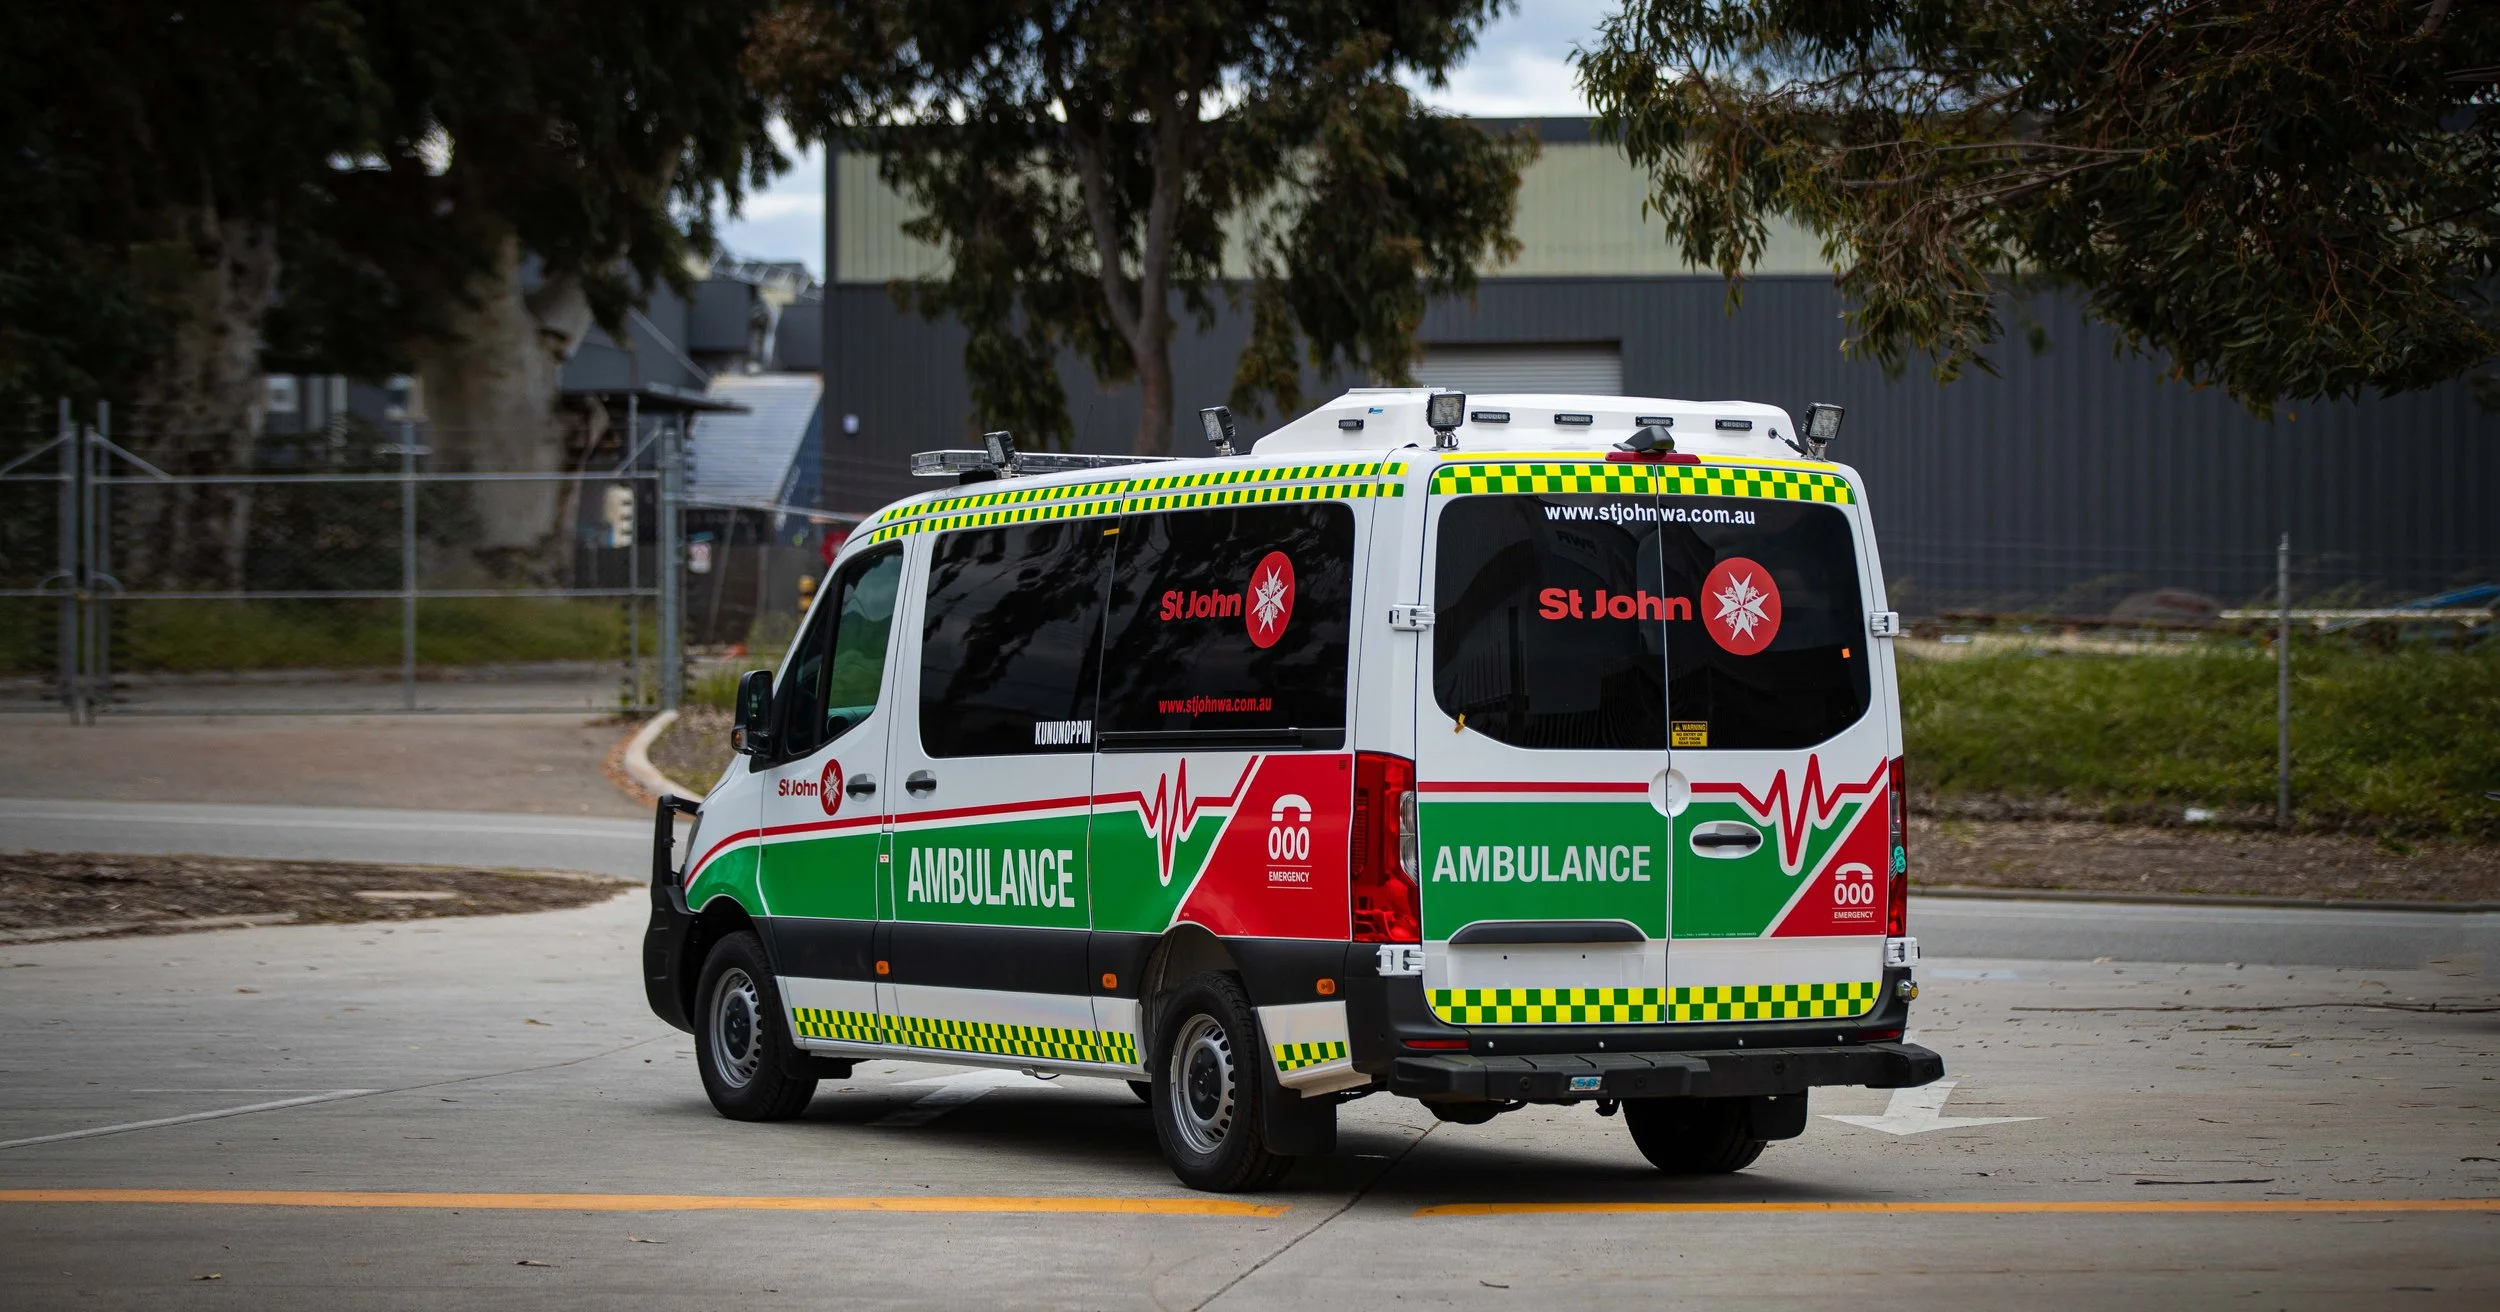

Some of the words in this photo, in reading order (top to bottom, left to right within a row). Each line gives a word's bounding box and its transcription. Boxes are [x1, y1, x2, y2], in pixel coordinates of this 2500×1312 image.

[1544, 503, 1756, 525] www.stjohnwa.com.au
[1159, 590, 1184, 621] St
[1185, 589, 1242, 619] John
[1538, 587, 1583, 620] St
[1591, 589, 1693, 621] John
[1159, 695, 1273, 718] www.stjohnwa.com.au
[1034, 719, 1092, 745] KUNUNOPPIN
[1681, 723, 1706, 731] WARNING
[778, 778, 789, 797] St
[791, 779, 818, 797] John
[1267, 826, 1310, 861] 000
[1431, 845, 1651, 883] AMBULANCE
[907, 847, 1076, 908] AMBULANCE
[1268, 870, 1310, 883] EMERGENCY
[1833, 882, 1874, 905] 000
[1833, 911, 1874, 919] EMERGENCY
